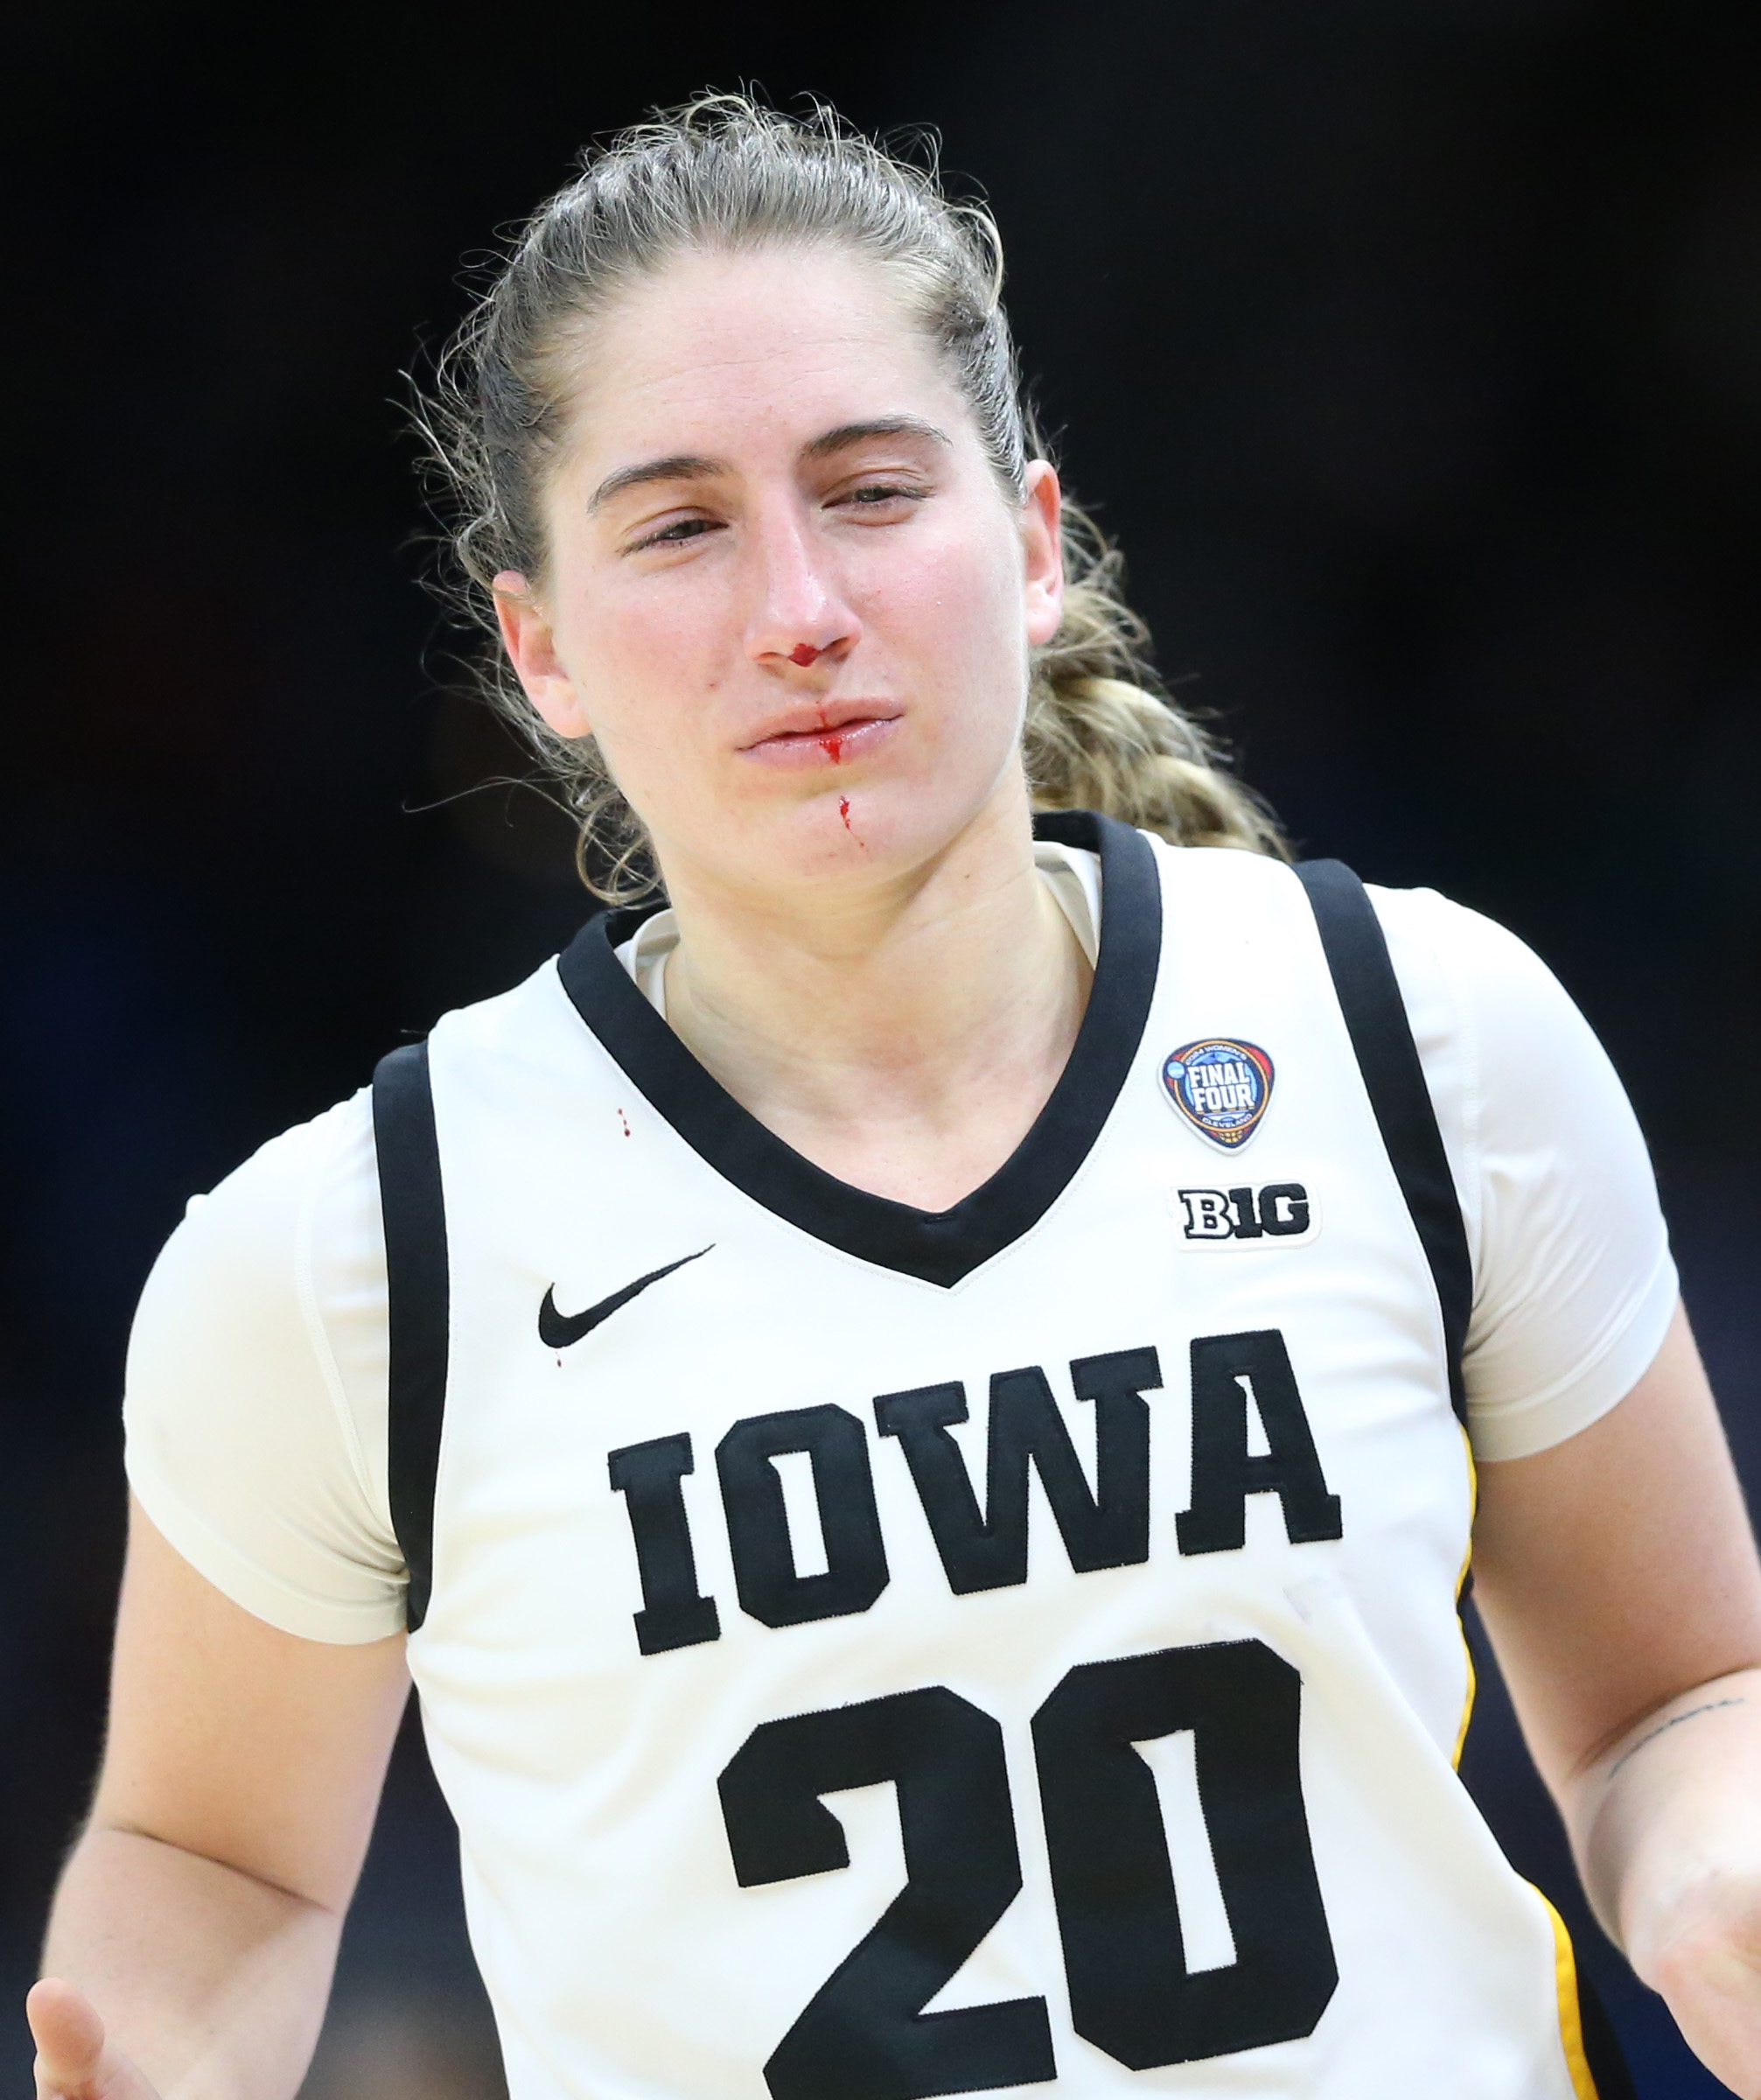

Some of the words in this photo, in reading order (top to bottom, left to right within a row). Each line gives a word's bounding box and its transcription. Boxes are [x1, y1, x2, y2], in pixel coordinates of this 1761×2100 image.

[1187, 1061, 1250, 1088] FINAL
[1191, 1083, 1255, 1115] FOUR
[1201, 1113, 1253, 1128] CLEVELAND
[607, 1329, 1343, 1656] IOWA
[716, 1638, 1339, 2100] 20
